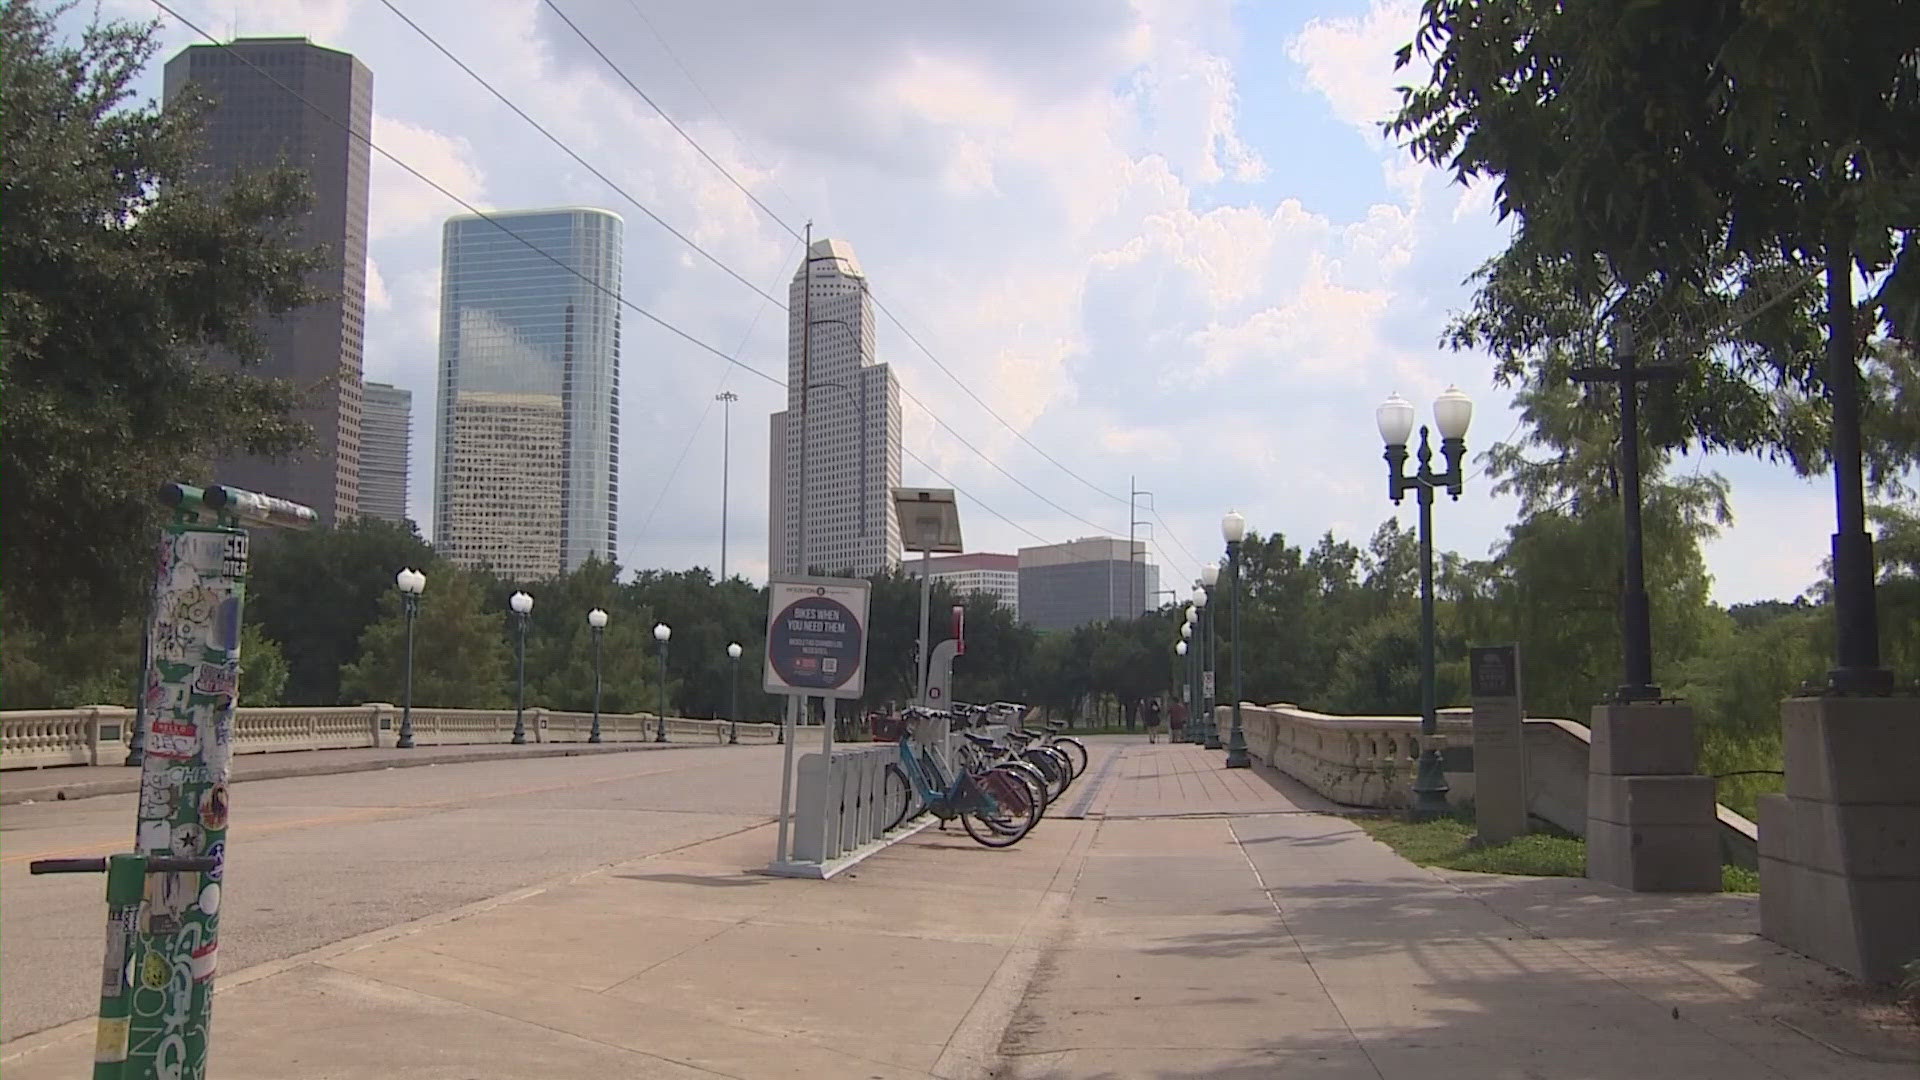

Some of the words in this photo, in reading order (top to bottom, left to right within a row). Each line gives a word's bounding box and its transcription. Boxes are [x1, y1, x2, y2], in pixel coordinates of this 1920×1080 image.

[794, 608, 816, 619] BIKES
[817, 609, 840, 620] WHEN
[787, 620, 804, 631] YOU
[804, 620, 823, 632] NEED
[824, 621, 846, 633] THEM
